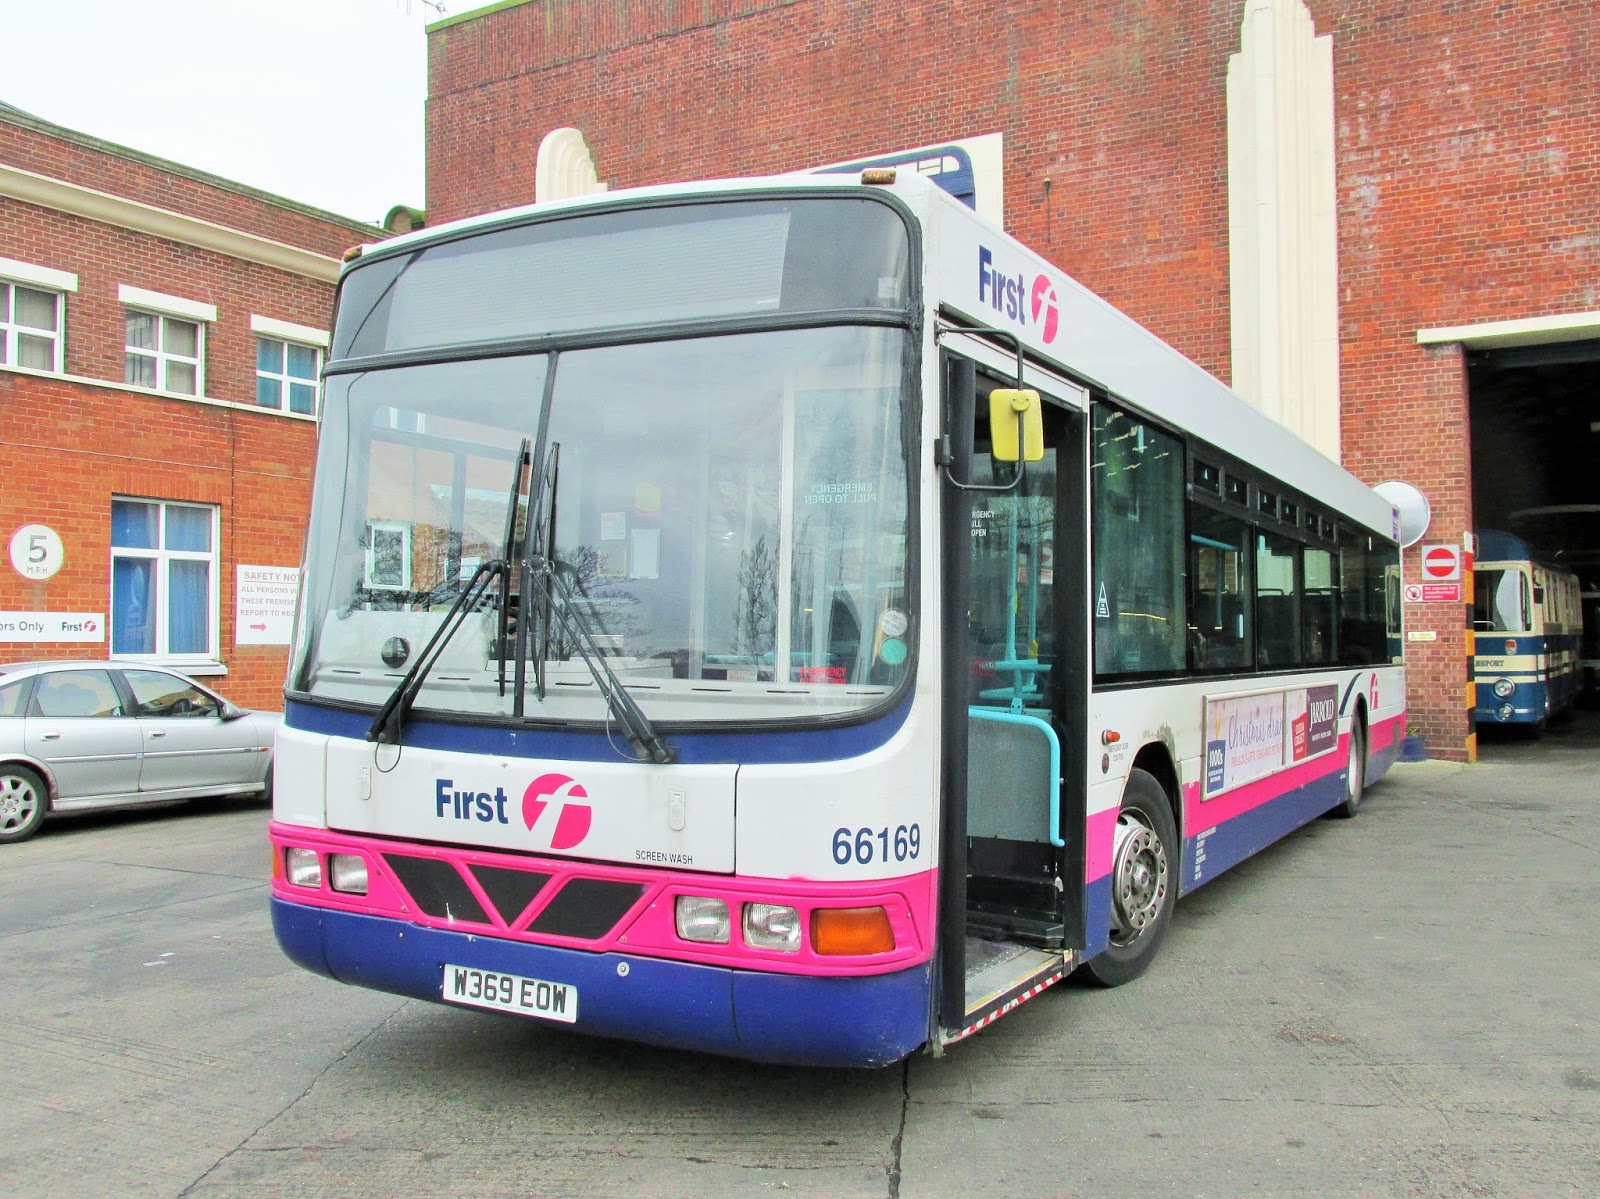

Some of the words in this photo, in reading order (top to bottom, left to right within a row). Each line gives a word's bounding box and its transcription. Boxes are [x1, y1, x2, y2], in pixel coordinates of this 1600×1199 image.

[978, 244, 1026, 326] First
[970, 528, 987, 537] OPEN
[29, 535, 48, 563] 5
[244, 571, 281, 580] SAFETY
[256, 586, 289, 594] PERSONS
[19, 620, 45, 633] Only
[61, 621, 83, 632] First
[1474, 659, 1505, 667] NSPORT
[1309, 699, 1334, 732] JARROLD
[436, 778, 509, 825] First
[832, 823, 920, 865] 66169
[635, 849, 668, 862] SCREEN
[669, 853, 693, 865] WASH
[454, 968, 514, 1004] W369
[520, 979, 567, 1014] EOW
